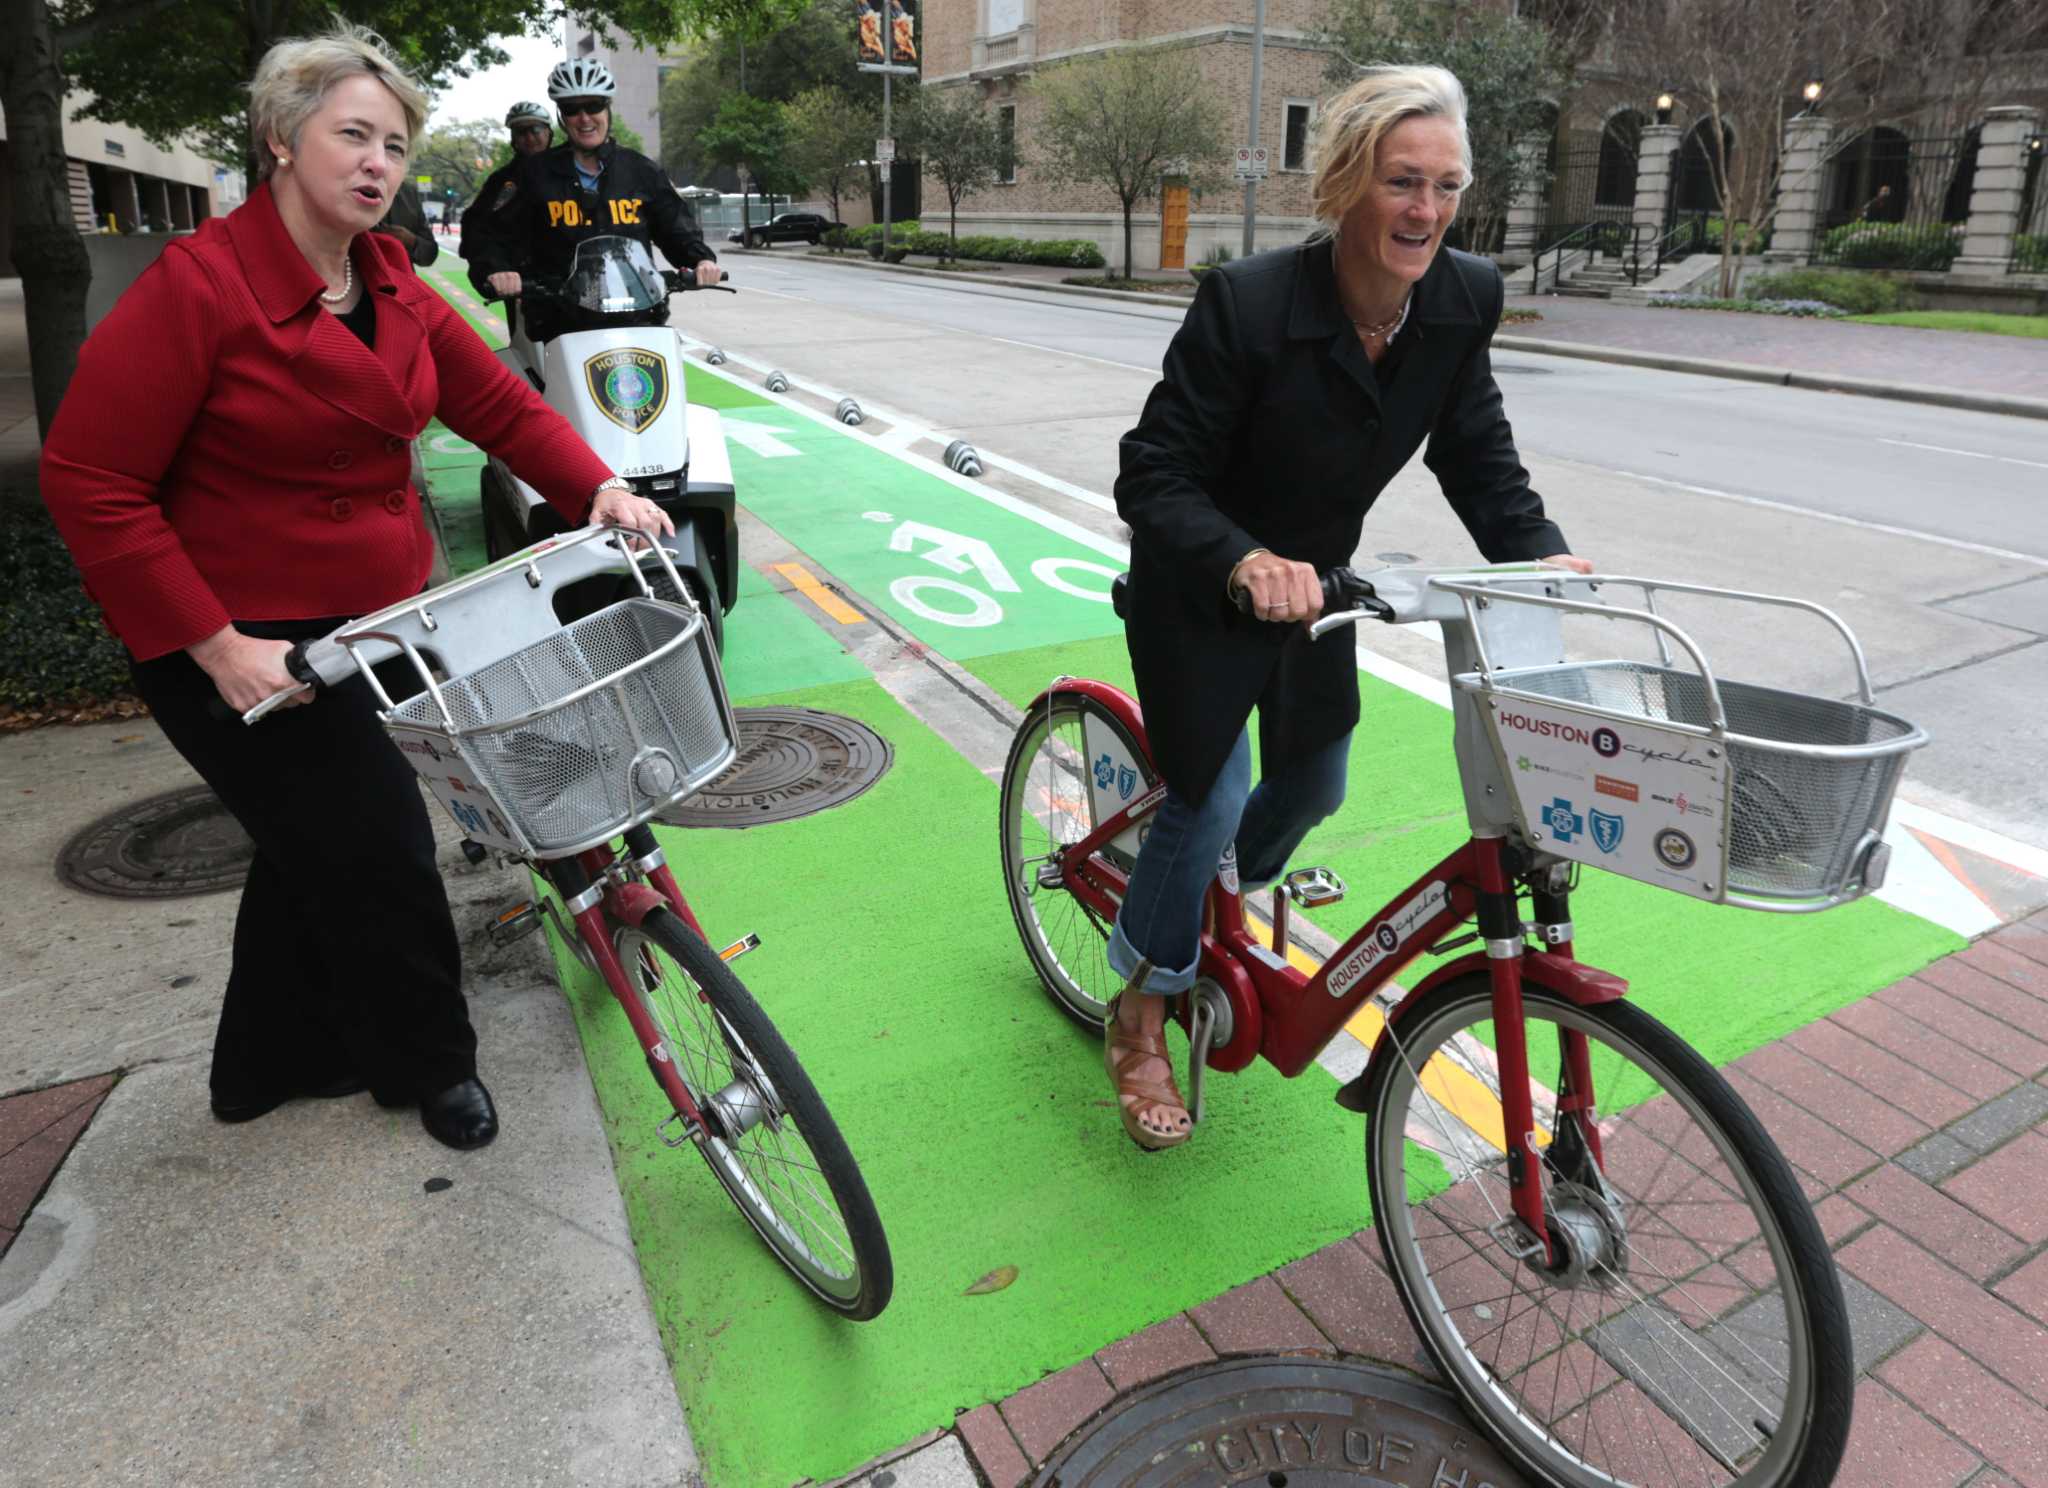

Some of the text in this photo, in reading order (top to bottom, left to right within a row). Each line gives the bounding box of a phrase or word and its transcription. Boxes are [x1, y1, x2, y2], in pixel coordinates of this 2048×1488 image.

[546, 198, 642, 227] POICE
[595, 353, 656, 371] HOUSTON
[612, 403, 656, 419] POLICE
[623, 463, 665, 477] 44438
[1500, 711, 1590, 747] HOUSTON
[1329, 942, 1382, 993] HOUSTON
[1213, 1420, 1321, 1474] CITY
[1343, 1427, 1414, 1471] OF
